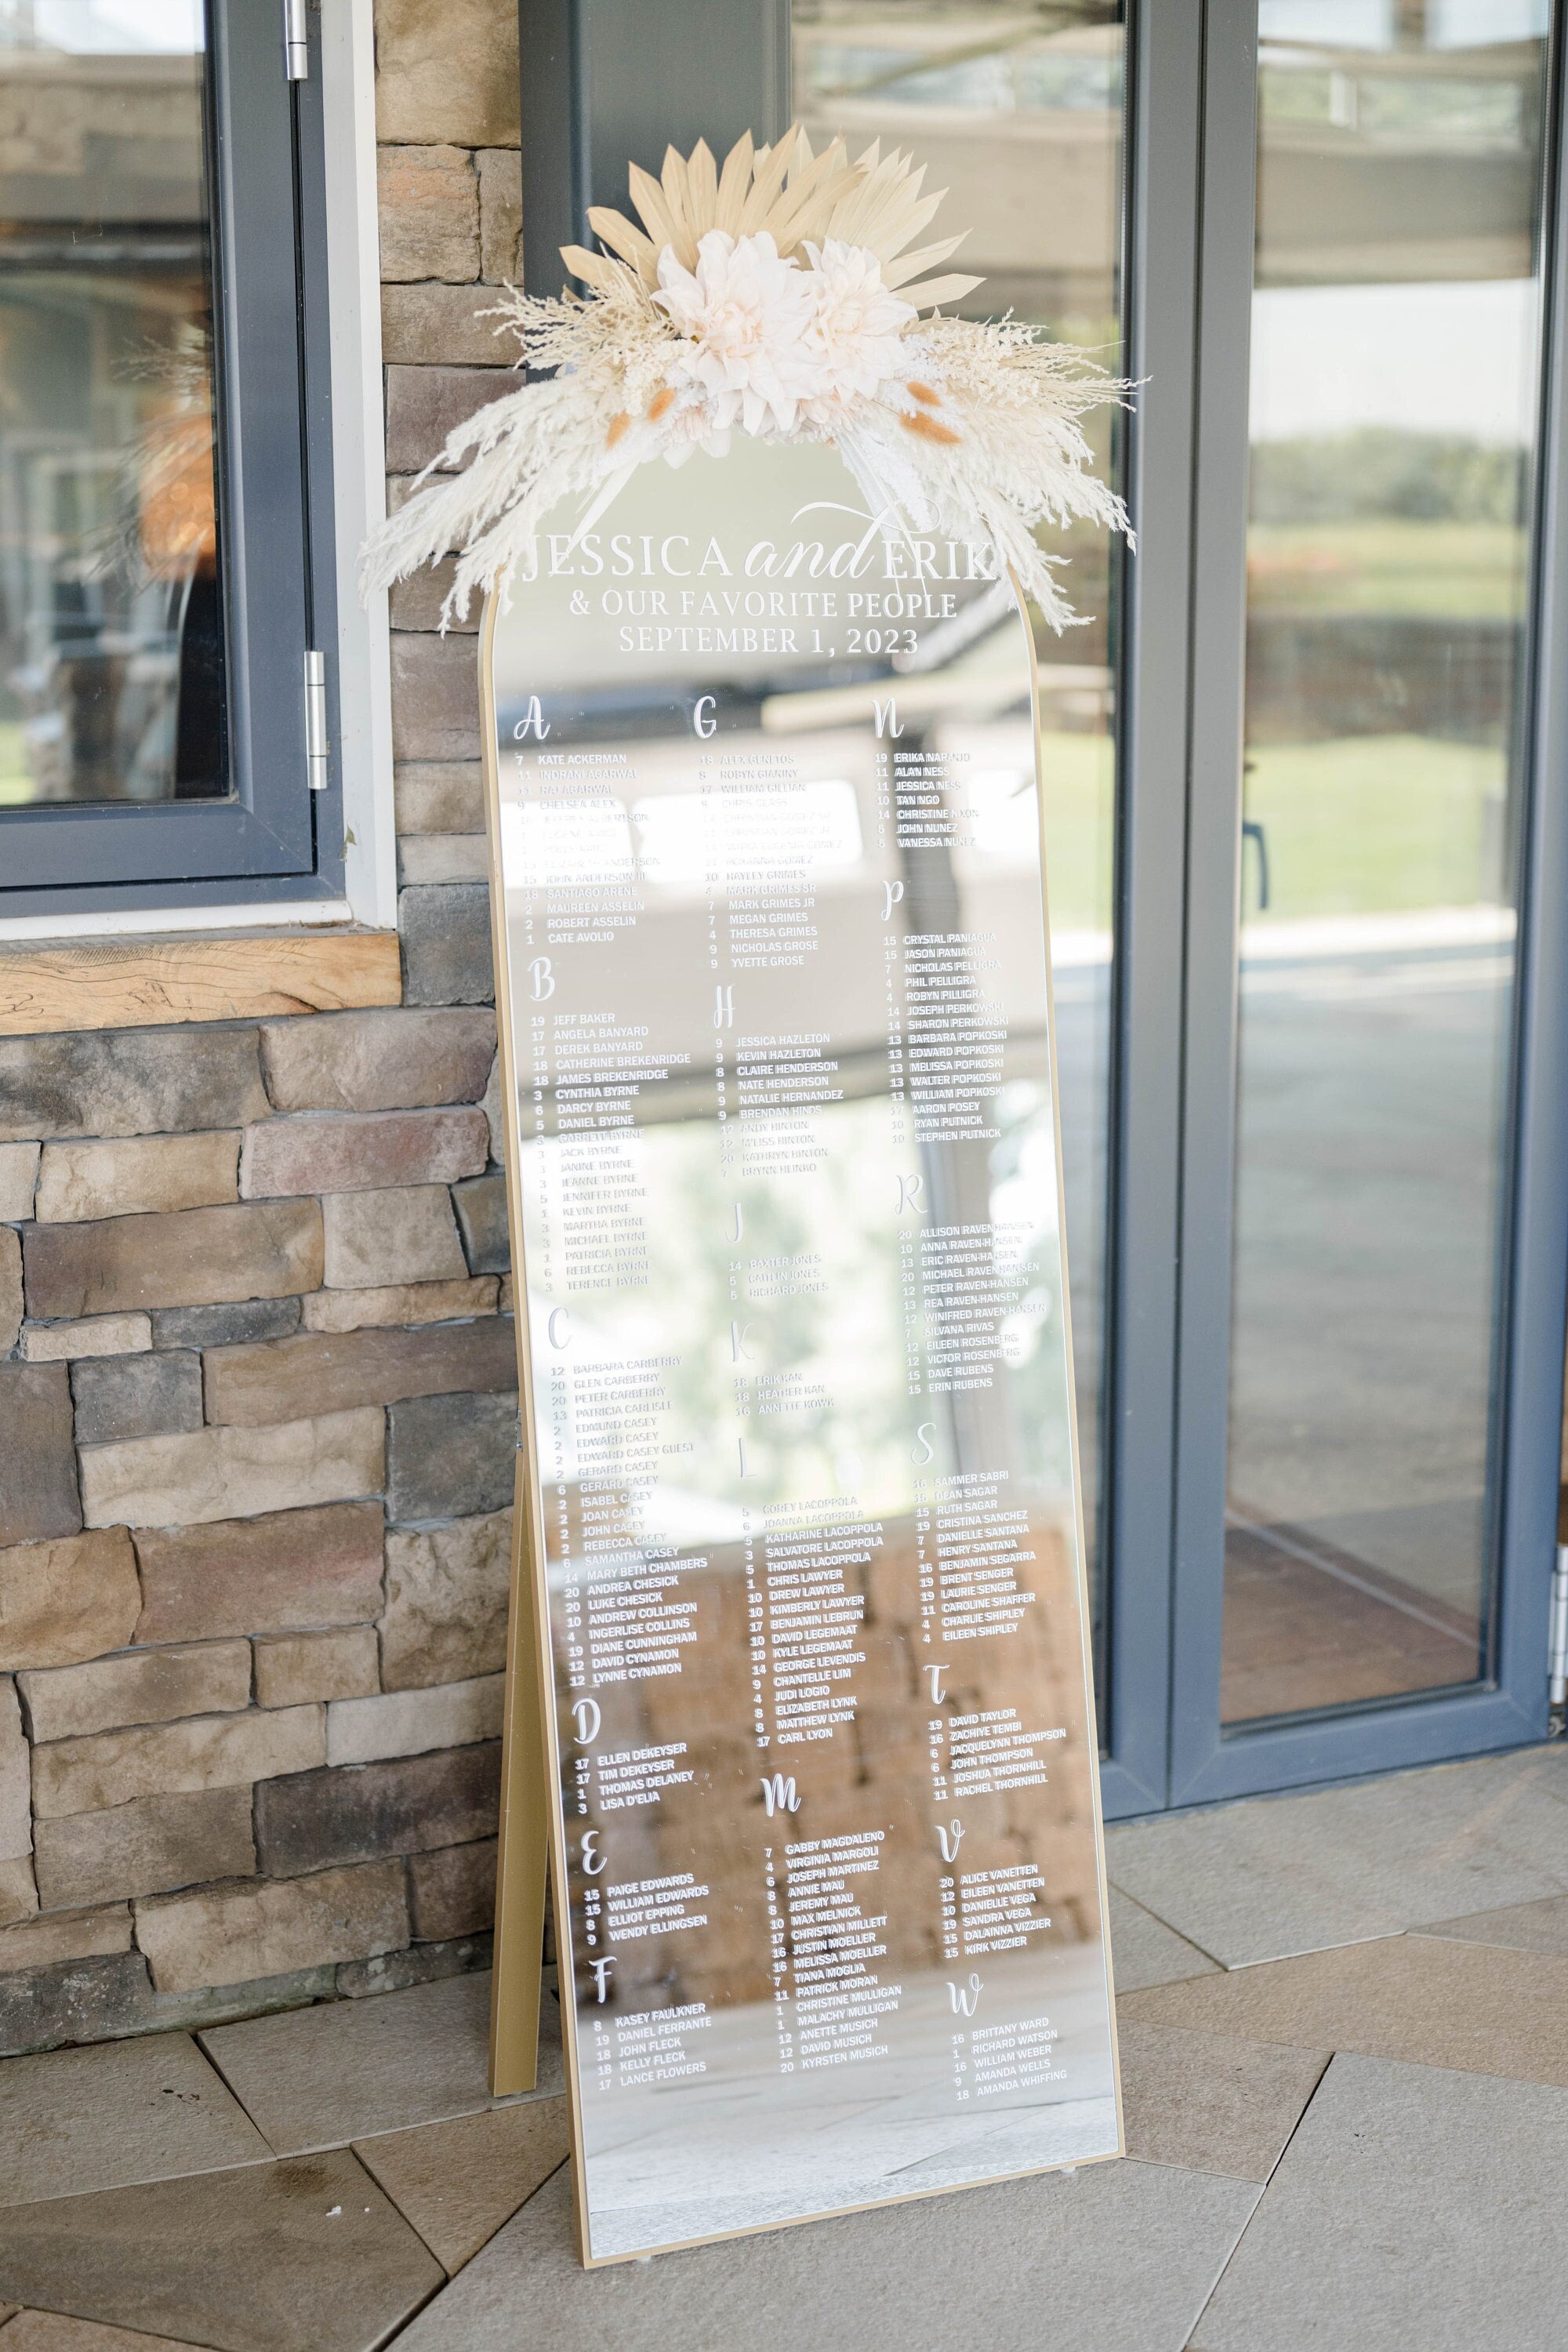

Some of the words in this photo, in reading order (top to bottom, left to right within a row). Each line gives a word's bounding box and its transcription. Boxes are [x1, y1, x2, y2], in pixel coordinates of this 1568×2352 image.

[521, 535, 731, 581] JESSICA
[744, 501, 942, 580] and
[883, 540, 997, 580] ERIK
[569, 590, 590, 614] &
[603, 590, 667, 615] OUR
[681, 591, 837, 616] FAVORITE
[847, 593, 956, 619] PEOPLE
[619, 626, 798, 652] SEPTEMBER
[811, 629, 836, 658] 1,
[847, 630, 918, 654] 2023
[514, 696, 550, 739] A
[694, 696, 717, 739] G
[516, 756, 523, 765] 7
[539, 755, 564, 765] KATE
[568, 754, 626, 764] ACKERMAN
[895, 768, 922, 777] ALAN
[924, 768, 949, 776] NESS
[877, 797, 889, 805] 10
[896, 796, 916, 805] TAN
[917, 795, 939, 804] NGO
[881, 880, 904, 921] P
[526, 920, 532, 929] 2
[547, 919, 590, 928] ROBERT
[593, 916, 637, 927] ASSELIN
[709, 916, 715, 925] 7
[730, 914, 766, 924] MEGAN
[769, 913, 808, 923] GRIMES
[527, 935, 535, 944] 1
[549, 934, 575, 943] CATE
[577, 931, 614, 942] AVOLIO
[710, 931, 716, 939] 4
[730, 928, 775, 938] THERESA
[779, 927, 818, 936] GRIMES
[710, 946, 717, 954] 9
[731, 943, 781, 953] NICHOLAS
[784, 941, 818, 951] GROSE
[711, 960, 718, 968] 9
[732, 957, 768, 967] YVETTE
[770, 956, 804, 965] GROSE
[527, 956, 556, 1001] B
[713, 985, 735, 1028] H
[531, 1017, 545, 1026] 19
[554, 1014, 576, 1025] JEFF
[580, 1013, 615, 1024] BAKER
[532, 1032, 545, 1041] 17
[554, 1029, 596, 1040] ANGELA
[599, 1026, 649, 1037] BANYARD
[715, 1039, 722, 1048] 9
[735, 1036, 776, 1047] JESSICA
[779, 1033, 830, 1044] HAZLETON
[908, 1033, 956, 1044] BARBARA
[959, 1030, 1007, 1040] POPKOSKI
[533, 1047, 546, 1056] 17
[555, 1044, 590, 1054] DEREK
[593, 1041, 643, 1052] BANYARD
[533, 1076, 549, 1085] 18
[555, 1074, 591, 1084] JAMES
[593, 1069, 669, 1082] BREKENRIDGE
[536, 1105, 543, 1115] 6
[557, 1102, 593, 1114] DARCY
[596, 1101, 631, 1112] BYRNE
[718, 1097, 725, 1105] 9
[739, 1094, 779, 1105] NATALIE
[782, 1090, 844, 1102] HERNANDEZ
[895, 1174, 927, 1214] R
[902, 1287, 915, 1296] 12
[923, 1283, 953, 1294] PETER
[956, 1277, 1029, 1292] RAVEN-HANSEN
[549, 1308, 572, 1349] C
[731, 1321, 755, 1363] K
[909, 1385, 921, 1395] 15
[928, 1382, 951, 1393] ERIN
[953, 1378, 993, 1390] RUBENS
[911, 1423, 936, 1465] S
[916, 1508, 929, 1517] 15
[937, 1504, 962, 1515] RUTH
[965, 1500, 997, 1512] SAGAR
[564, 1559, 571, 1568] 6
[584, 1552, 643, 1566] SAMANTHA
[645, 1547, 679, 1559] CASEY
[917, 1550, 925, 1559] 7
[938, 1545, 971, 1557] HENRY
[972, 1540, 1018, 1553] SANTANA
[564, 1588, 579, 1598] 20
[587, 1582, 632, 1595] ANDREA
[633, 1576, 679, 1589] CHESICK
[747, 1580, 755, 1588] 1
[768, 1574, 800, 1586] CHRIS
[800, 1570, 843, 1582] LAWYER
[753, 1680, 760, 1690] 9
[773, 1672, 831, 1687] CHANTELLE
[833, 1668, 851, 1680] LIM
[923, 1664, 950, 1704] T
[753, 1694, 762, 1704] 4
[775, 1690, 797, 1701] JUDI
[800, 1686, 829, 1698] LOGIO
[572, 1698, 601, 1744] D
[575, 1759, 589, 1770] 17
[597, 1752, 630, 1766] ELLEN
[633, 1743, 687, 1760] DEKEYSER
[931, 1763, 939, 1773] 6
[951, 1756, 977, 1770] JOHN
[979, 1748, 1033, 1765] THOMPSON
[578, 1789, 586, 1799] 1
[599, 1780, 644, 1795] THOMAS
[646, 1770, 694, 1788] DELANEY
[581, 1831, 608, 1875] E
[935, 1820, 965, 1863] V
[584, 1889, 600, 1901] 15
[607, 1881, 639, 1896] PAIGE
[641, 1873, 694, 1892] EDWARDS
[768, 1891, 775, 1900] 8
[788, 1883, 820, 1897] ANNIE
[821, 1880, 844, 1892] MAU
[589, 1955, 617, 2003] F
[946, 1973, 984, 2017] W
[596, 2035, 609, 2046] 19
[619, 2025, 656, 2042] DANIEL
[659, 2016, 712, 2035] FERRANTE
[952, 2034, 964, 2045] 16
[972, 2024, 1018, 2041] BRITTANY
[1019, 2018, 1048, 2031] WARD
[597, 2050, 611, 2060] 18
[619, 2042, 648, 2057] JOHN
[648, 2037, 681, 2051] FLECK
[780, 2048, 793, 2059] 12
[802, 2042, 830, 2055] DAVID
[833, 2034, 872, 2049] MUSICH
[953, 2050, 960, 2059] 1
[972, 2038, 1015, 2055] RICHARD
[1018, 2030, 1058, 2045] WATSON
[781, 2063, 793, 2073] 20
[802, 2053, 847, 2069] KYRSTEN
[850, 2045, 888, 2060] MUSICH
[599, 2079, 612, 2090] 17
[620, 2071, 654, 2086] LANCE
[657, 2062, 706, 2080] FLOWERS
[955, 2078, 961, 2086] 9
[975, 2067, 1017, 2083] AMANDA
[1019, 2060, 1051, 2074] WELLS
[956, 2089, 969, 2101] 18
[977, 2081, 1019, 2097] AMANDA
[1021, 2070, 1067, 2087] WHIFFING
